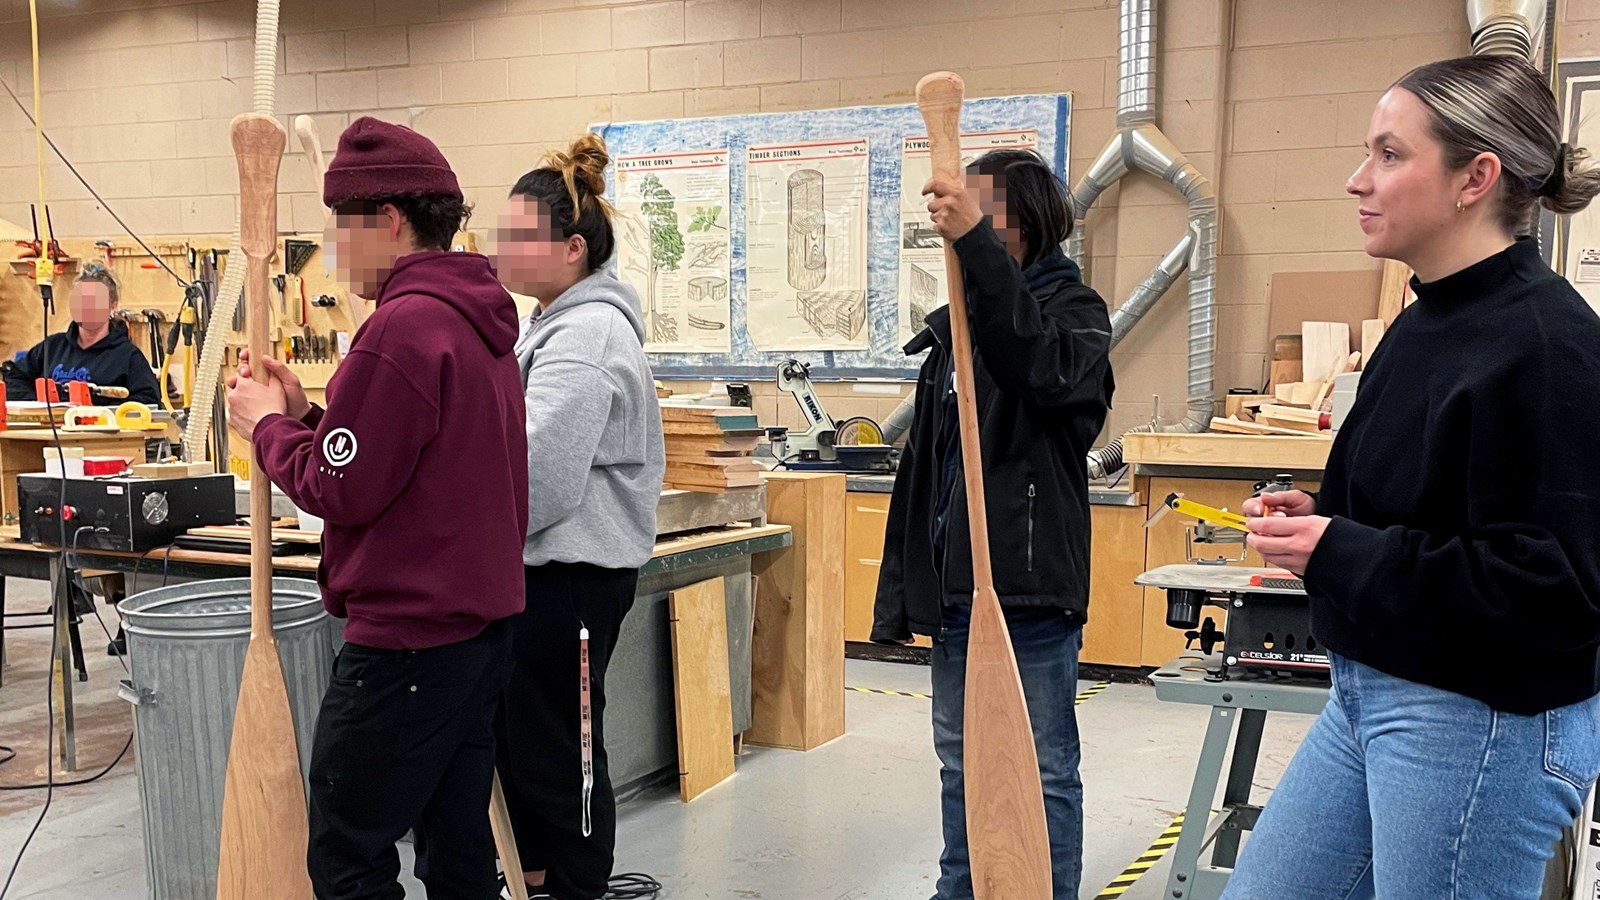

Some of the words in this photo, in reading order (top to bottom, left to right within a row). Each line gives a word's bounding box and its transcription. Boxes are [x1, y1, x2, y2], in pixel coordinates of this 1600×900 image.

[749, 151, 770, 160] TIMBER
[773, 149, 801, 158] SECTIONS
[617, 160, 630, 168] HOW
[639, 159, 652, 167] TREE
[653, 158, 673, 167] GROWS
[803, 395, 822, 422] RIKON
